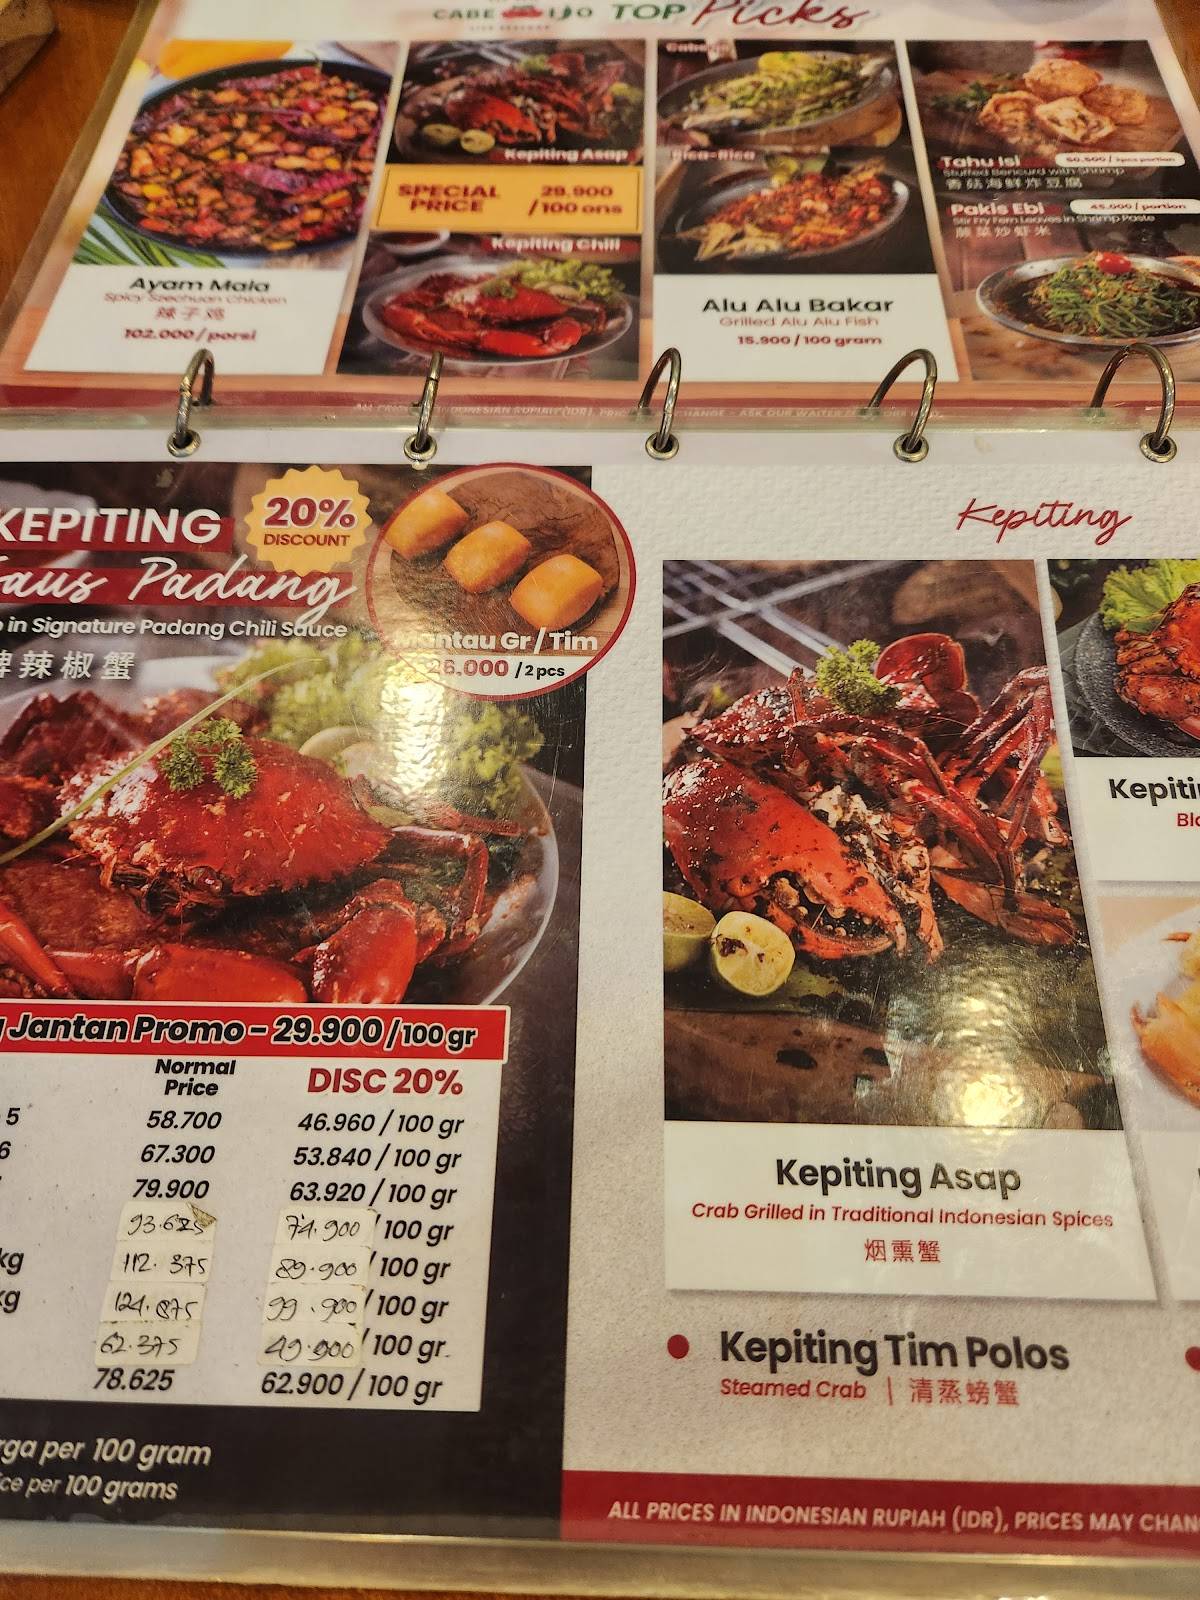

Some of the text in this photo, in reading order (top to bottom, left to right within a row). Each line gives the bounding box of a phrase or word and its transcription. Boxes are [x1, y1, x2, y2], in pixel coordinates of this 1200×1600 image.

[433, 8, 494, 19] CABE
[612, 4, 686, 20] TOP
[504, 149, 628, 162] Kepiting Asap
[941, 155, 1021, 168] Tahu Isi
[1048, 166, 1074, 176] with
[397, 184, 500, 199] SPECIAL
[410, 199, 483, 212] PRICE
[950, 202, 1045, 216] Pakis Ebi
[1076, 214, 1121, 224] Shrimp
[1121, 213, 1155, 222] Paste
[491, 237, 621, 252] Kepiting Chili
[129, 277, 270, 294] Ayam Mala
[702, 298, 894, 312] Alu Alu Bakar
[719, 316, 879, 327] Grilled Alu Alu Fish
[804, 335, 831, 345] 100
[834, 337, 882, 348] gram
[263, 496, 357, 529] 20%
[956, 497, 1133, 546] Kepiting
[263, 533, 350, 547] DISCOUNT
[128, 554, 358, 627] Padang
[8, 617, 29, 634] in
[31, 617, 137, 639] Signature
[139, 619, 225, 641] Padang
[229, 619, 277, 637] Chili
[281, 621, 348, 638] Sauce
[500, 631, 531, 651] Gr
[548, 630, 598, 651] Tim
[1108, 776, 1200, 807] Kepiti
[9, 1013, 127, 1043] Jantan
[135, 1016, 246, 1045] Promo
[270, 1016, 382, 1045] 29.900
[446, 1027, 477, 1051] gr
[155, 1058, 236, 1077] Normal
[164, 1077, 219, 1096] Price
[307, 1067, 464, 1096] DISC 20%
[6, 1108, 20, 1126] 5
[147, 1109, 222, 1130] 58.700
[298, 1109, 464, 1138] 46.960 / 100 gr
[140, 1144, 215, 1165] 67.300
[293, 1143, 462, 1173] 53.840 / 100 gr
[132, 1178, 209, 1199] 79.900
[776, 1158, 1021, 1201] Kepiting Asap
[290, 1178, 457, 1209] 63.920 / 100 gr
[692, 1202, 1113, 1230] Crab Grilled in Traditional Indonesian Spices
[383, 1219, 454, 1246] 100 gr
[864, 1238, 941, 1263] 烟熏蟹
[379, 1257, 451, 1283] 100 gr
[376, 1295, 416, 1318] 100
[419, 1298, 449, 1322] gr
[100, 1331, 180, 1357] 62.375
[372, 1335, 412, 1357] 100
[416, 1338, 446, 1362] gr
[721, 1329, 1070, 1376] Kepiting Tim Polos
[94, 1368, 174, 1391] 78.625
[261, 1369, 442, 1402] 62.900 / 100 gr
[720, 1377, 1020, 1406] Steamed Crab 清蒸螃蟹
[39, 1440, 86, 1466] per
[93, 1438, 136, 1463] 100
[136, 1443, 212, 1471] gram
[25, 1474, 179, 1504] per 100 grams
[608, 1500, 640, 1519] ALL
[646, 1502, 716, 1522] PRICES
[720, 1504, 741, 1522] IN
[746, 1504, 868, 1526] INDONESIAN
[872, 1507, 947, 1528] RUPIAH
[952, 1505, 1010, 1534] (IDR),
[1014, 1511, 1084, 1531] PRICES
[1090, 1512, 1134, 1531] MAY
